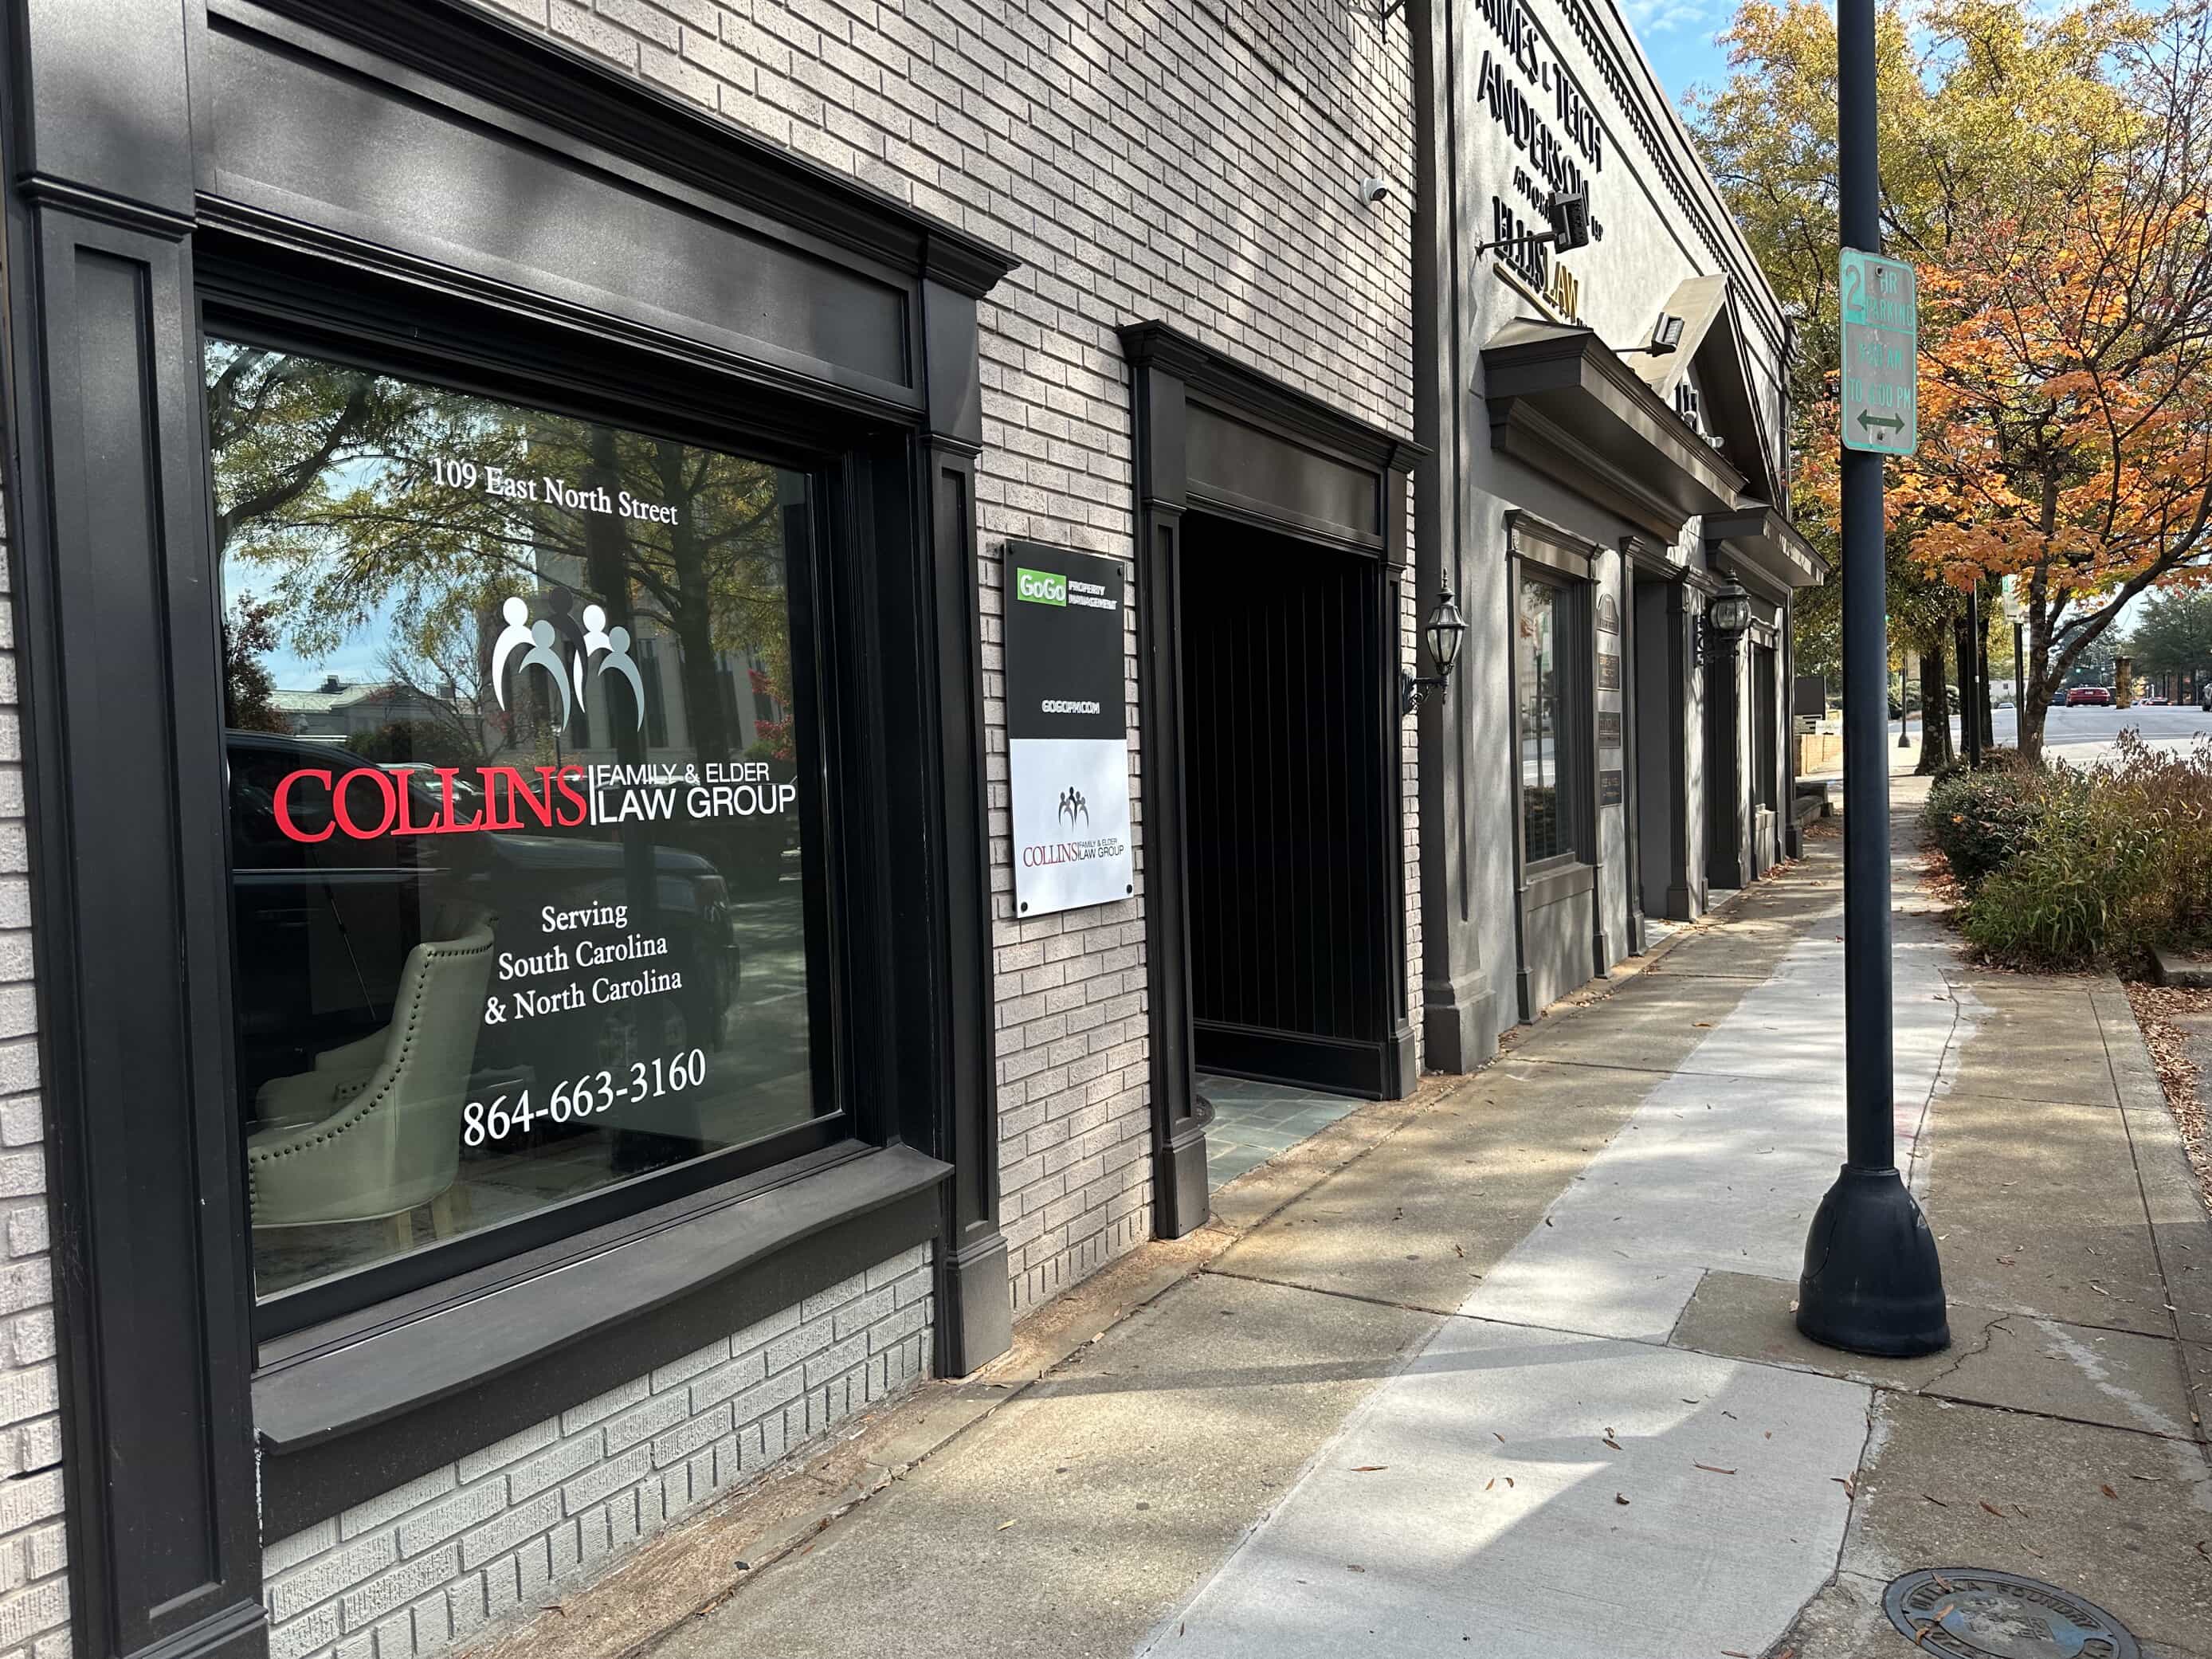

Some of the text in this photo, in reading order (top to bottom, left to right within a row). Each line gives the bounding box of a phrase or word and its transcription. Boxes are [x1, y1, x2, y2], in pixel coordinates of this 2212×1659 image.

[1477, 49, 1590, 226] ANDERSON
[1542, 246, 1579, 325] LAW
[1845, 265, 1862, 312] 2
[1865, 297, 1912, 327] PARKING
[1886, 346, 1903, 371] AM
[1849, 378, 1862, 402] TO
[1896, 385, 1912, 410] PM
[432, 457, 679, 527] 109 East North Street
[1019, 574, 1066, 602] GoGo
[1068, 580, 1106, 596] PROPERTY
[596, 762, 769, 787] FAMILY & ELDER
[273, 764, 588, 844] COLLINS
[598, 784, 796, 823] LAW GROUP
[1023, 841, 1078, 867] COLLINS
[1079, 841, 1096, 849] FAMILY
[1101, 837, 1118, 846] ELDER
[1079, 845, 1125, 861] LAW GROUP
[541, 901, 629, 933] Serving
[498, 935, 669, 981] South Carolina
[484, 967, 682, 1025] & North Carolina
[463, 1049, 707, 1147] 864-663-3160
